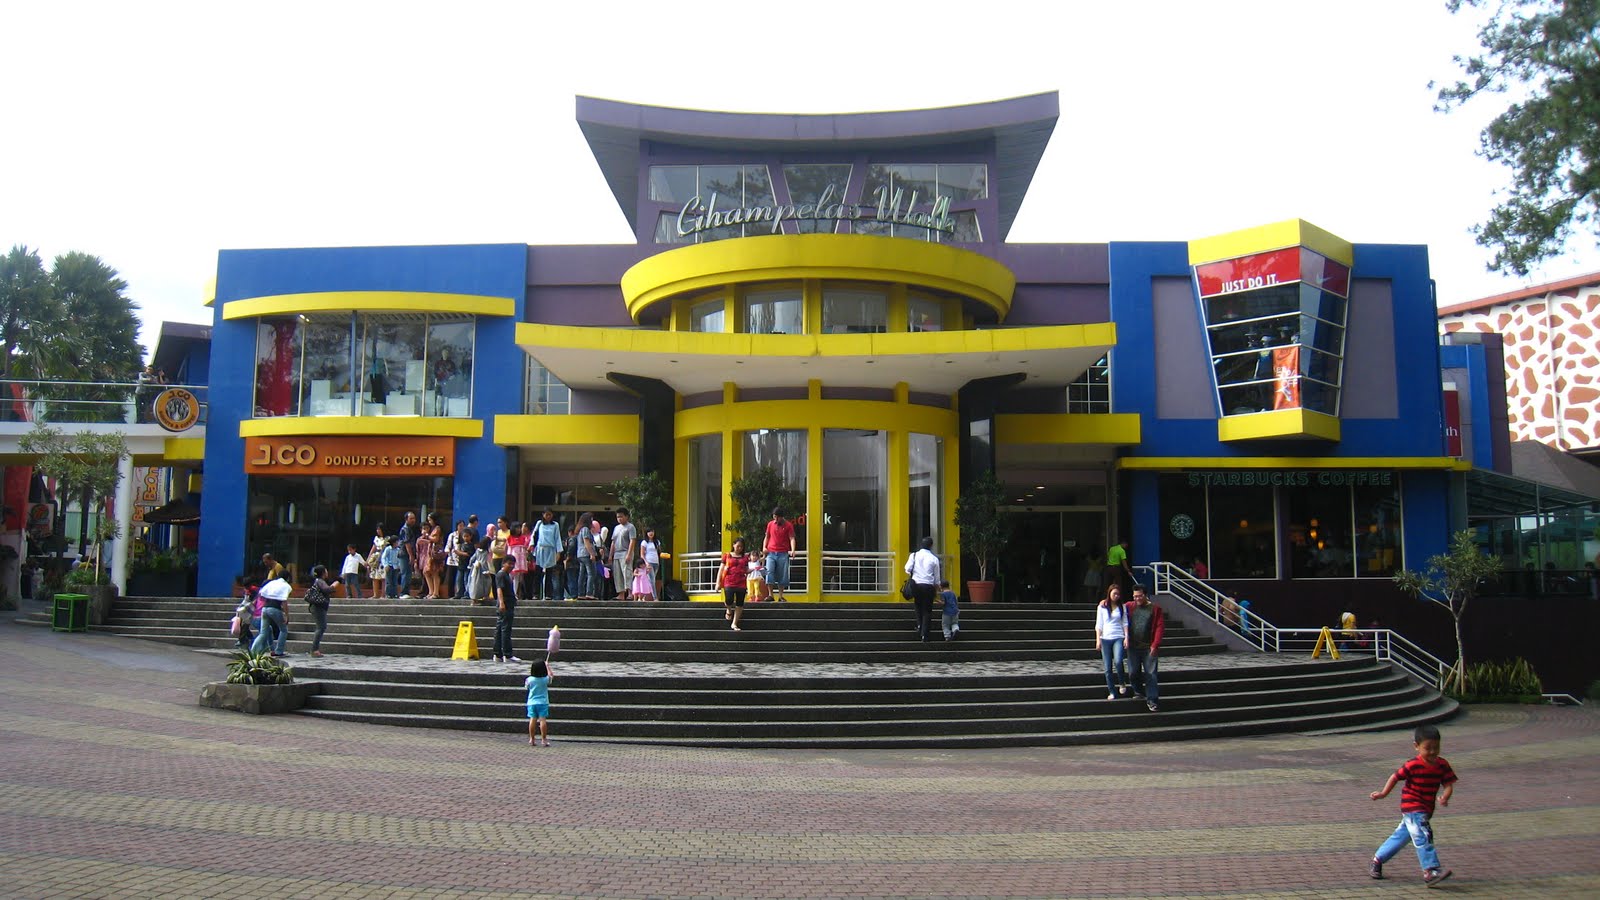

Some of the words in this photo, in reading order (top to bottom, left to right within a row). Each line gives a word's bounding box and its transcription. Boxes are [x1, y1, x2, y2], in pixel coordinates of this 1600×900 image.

[676, 184, 862, 237] Cihampelas
[873, 185, 956, 234] Walk
[1220, 279, 1245, 293] JUST
[1248, 277, 1263, 289] DO
[1266, 273, 1280, 285] IT.
[251, 444, 317, 466] J.CO
[324, 455, 378, 467] DONUTS
[380, 455, 390, 467] &
[394, 455, 445, 467] COFFEE
[1188, 472, 1309, 486] STARBUCKS
[1318, 472, 1392, 486] COFFEE
